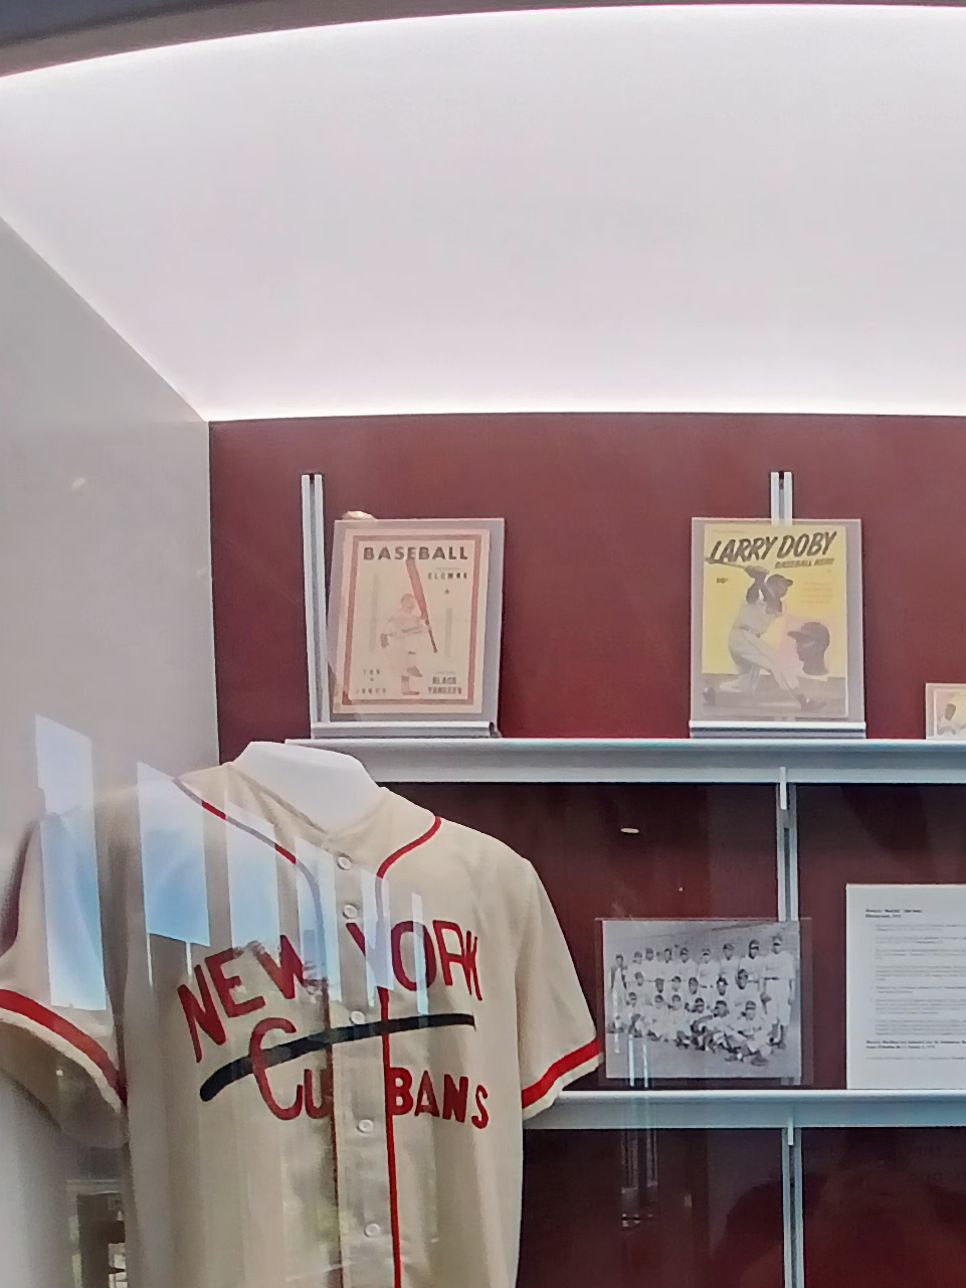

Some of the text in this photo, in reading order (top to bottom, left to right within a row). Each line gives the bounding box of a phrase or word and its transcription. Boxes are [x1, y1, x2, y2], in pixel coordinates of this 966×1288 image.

[363, 546, 469, 561] BASEBALL
[710, 531, 837, 562] LARRY DOBY
[177, 920, 483, 1063] NEW YORK
